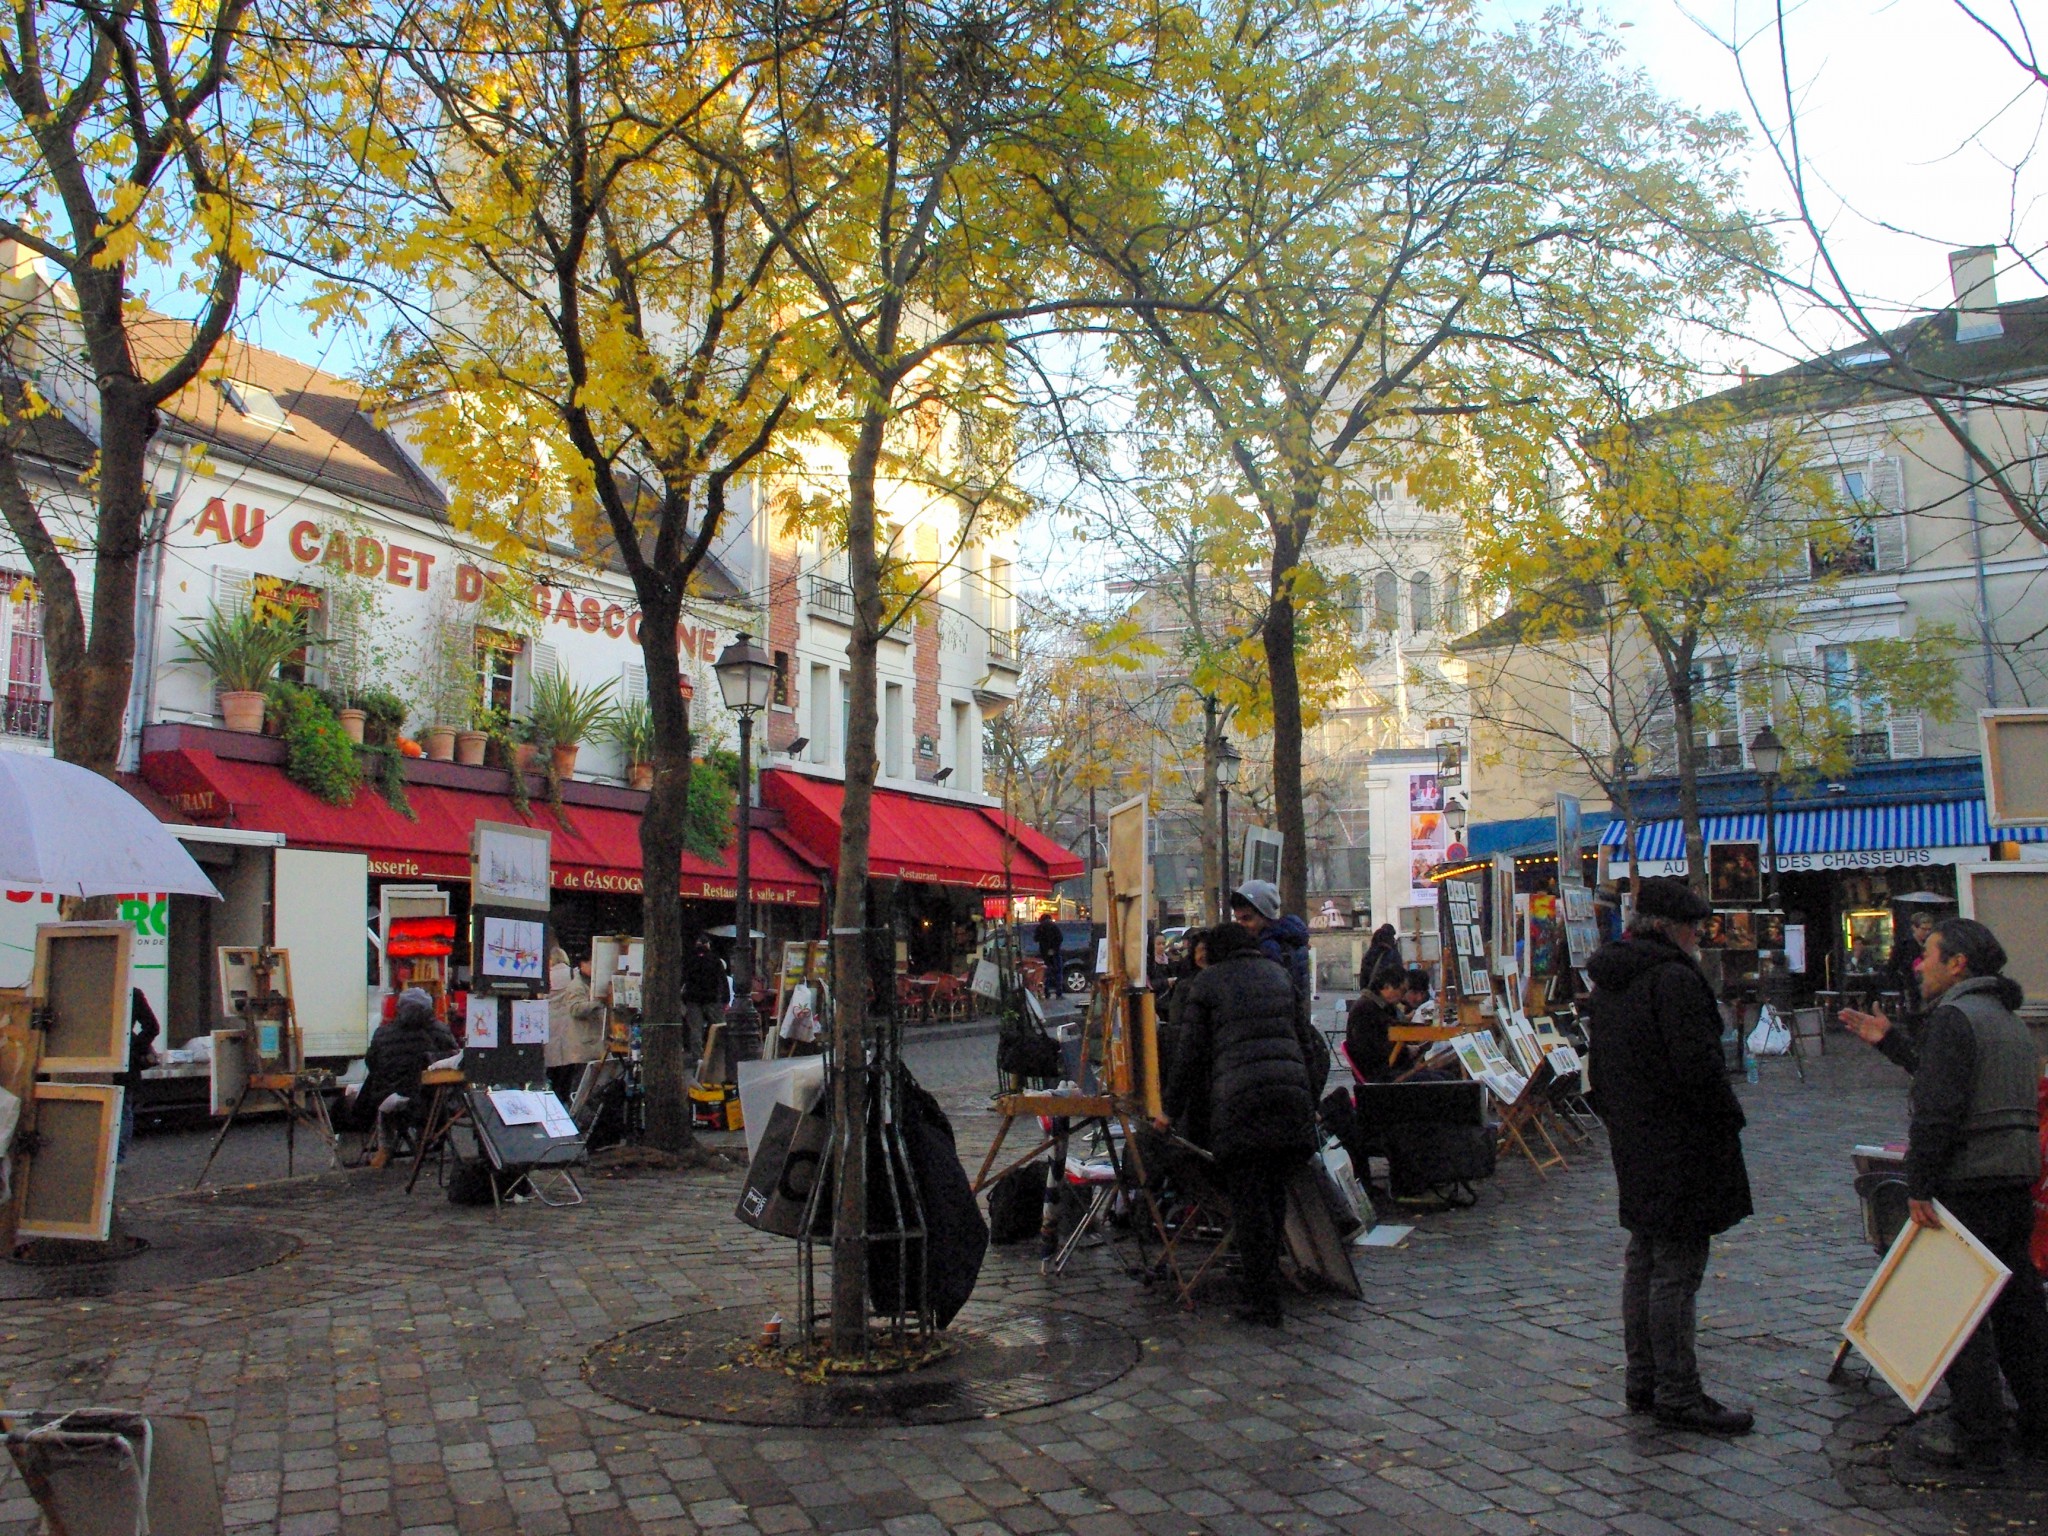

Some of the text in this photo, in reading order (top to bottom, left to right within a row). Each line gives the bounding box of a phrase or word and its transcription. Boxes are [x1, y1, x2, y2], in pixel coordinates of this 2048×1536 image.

[194, 496, 265, 549] AU
[289, 520, 436, 592] CADET
[529, 584, 718, 663] GASCONE
[899, 866, 938, 881] Restaurant
[1664, 861, 1685, 874] AU
[1778, 855, 1811, 869] DES
[1822, 849, 1931, 868] CHASSEURS
[367, 858, 419, 876] asserie
[564, 873, 579, 887] de
[583, 870, 644, 891] GASCOGN
[152, 938, 165, 946] DE
